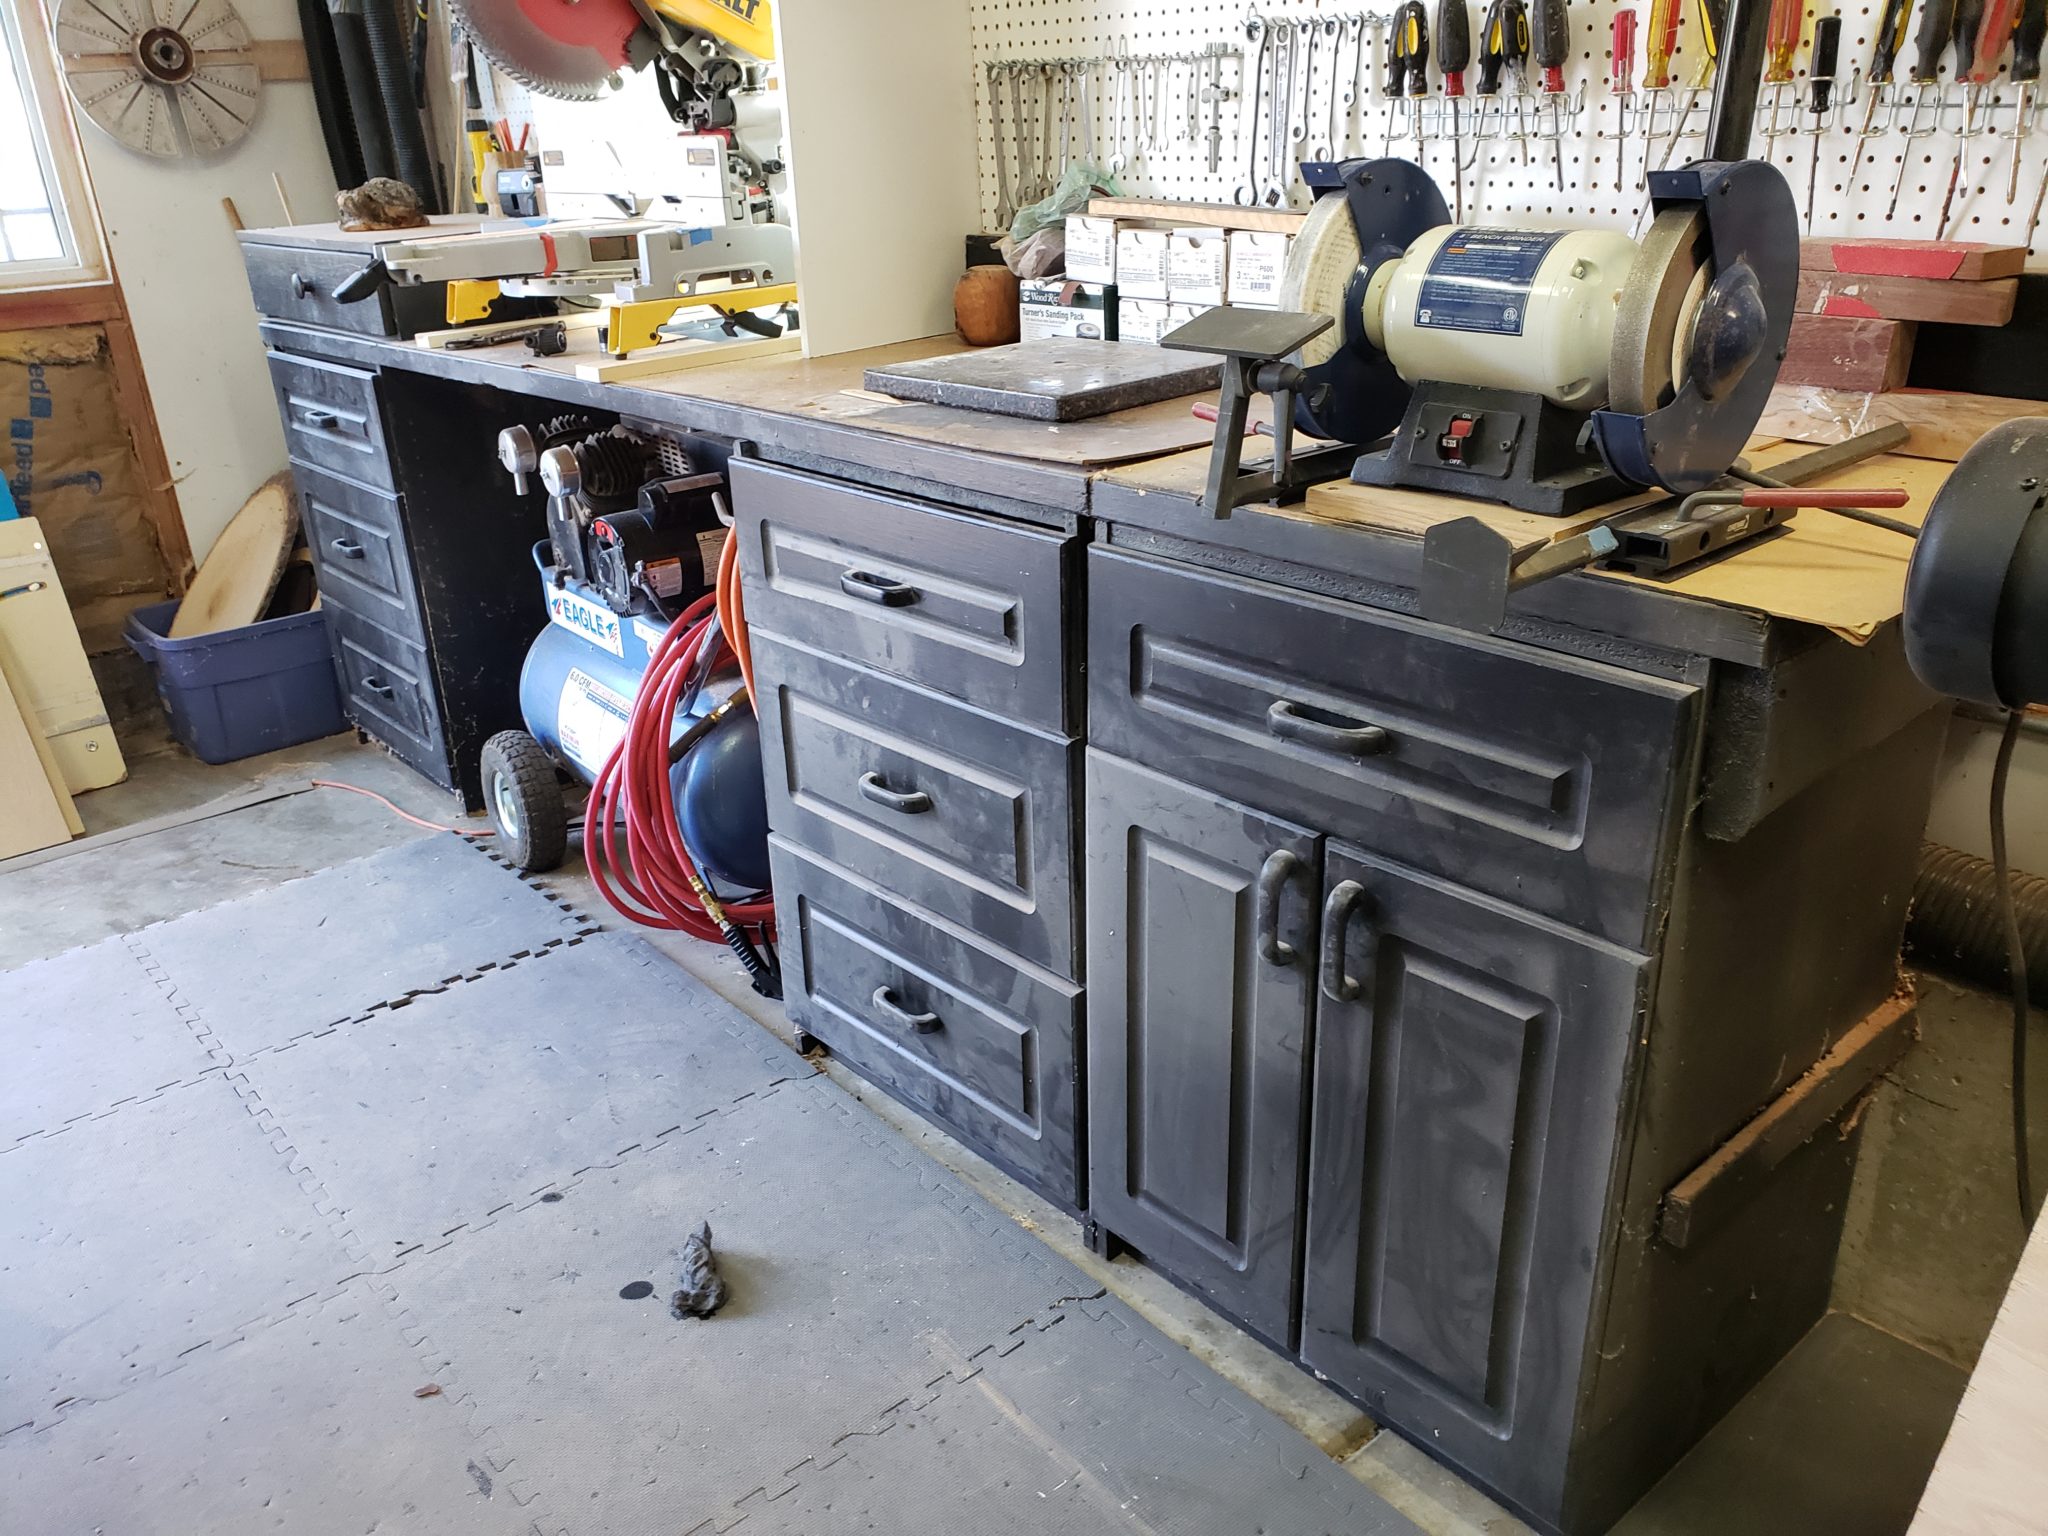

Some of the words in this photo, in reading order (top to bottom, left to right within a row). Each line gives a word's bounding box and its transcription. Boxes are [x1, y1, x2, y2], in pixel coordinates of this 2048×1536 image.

[1022, 307, 1045, 318] Turner's
[1045, 309, 1069, 321] Sanding
[1069, 311, 1085, 321] Pack
[562, 598, 606, 639] EAGLE
[579, 676, 592, 690] CFM
